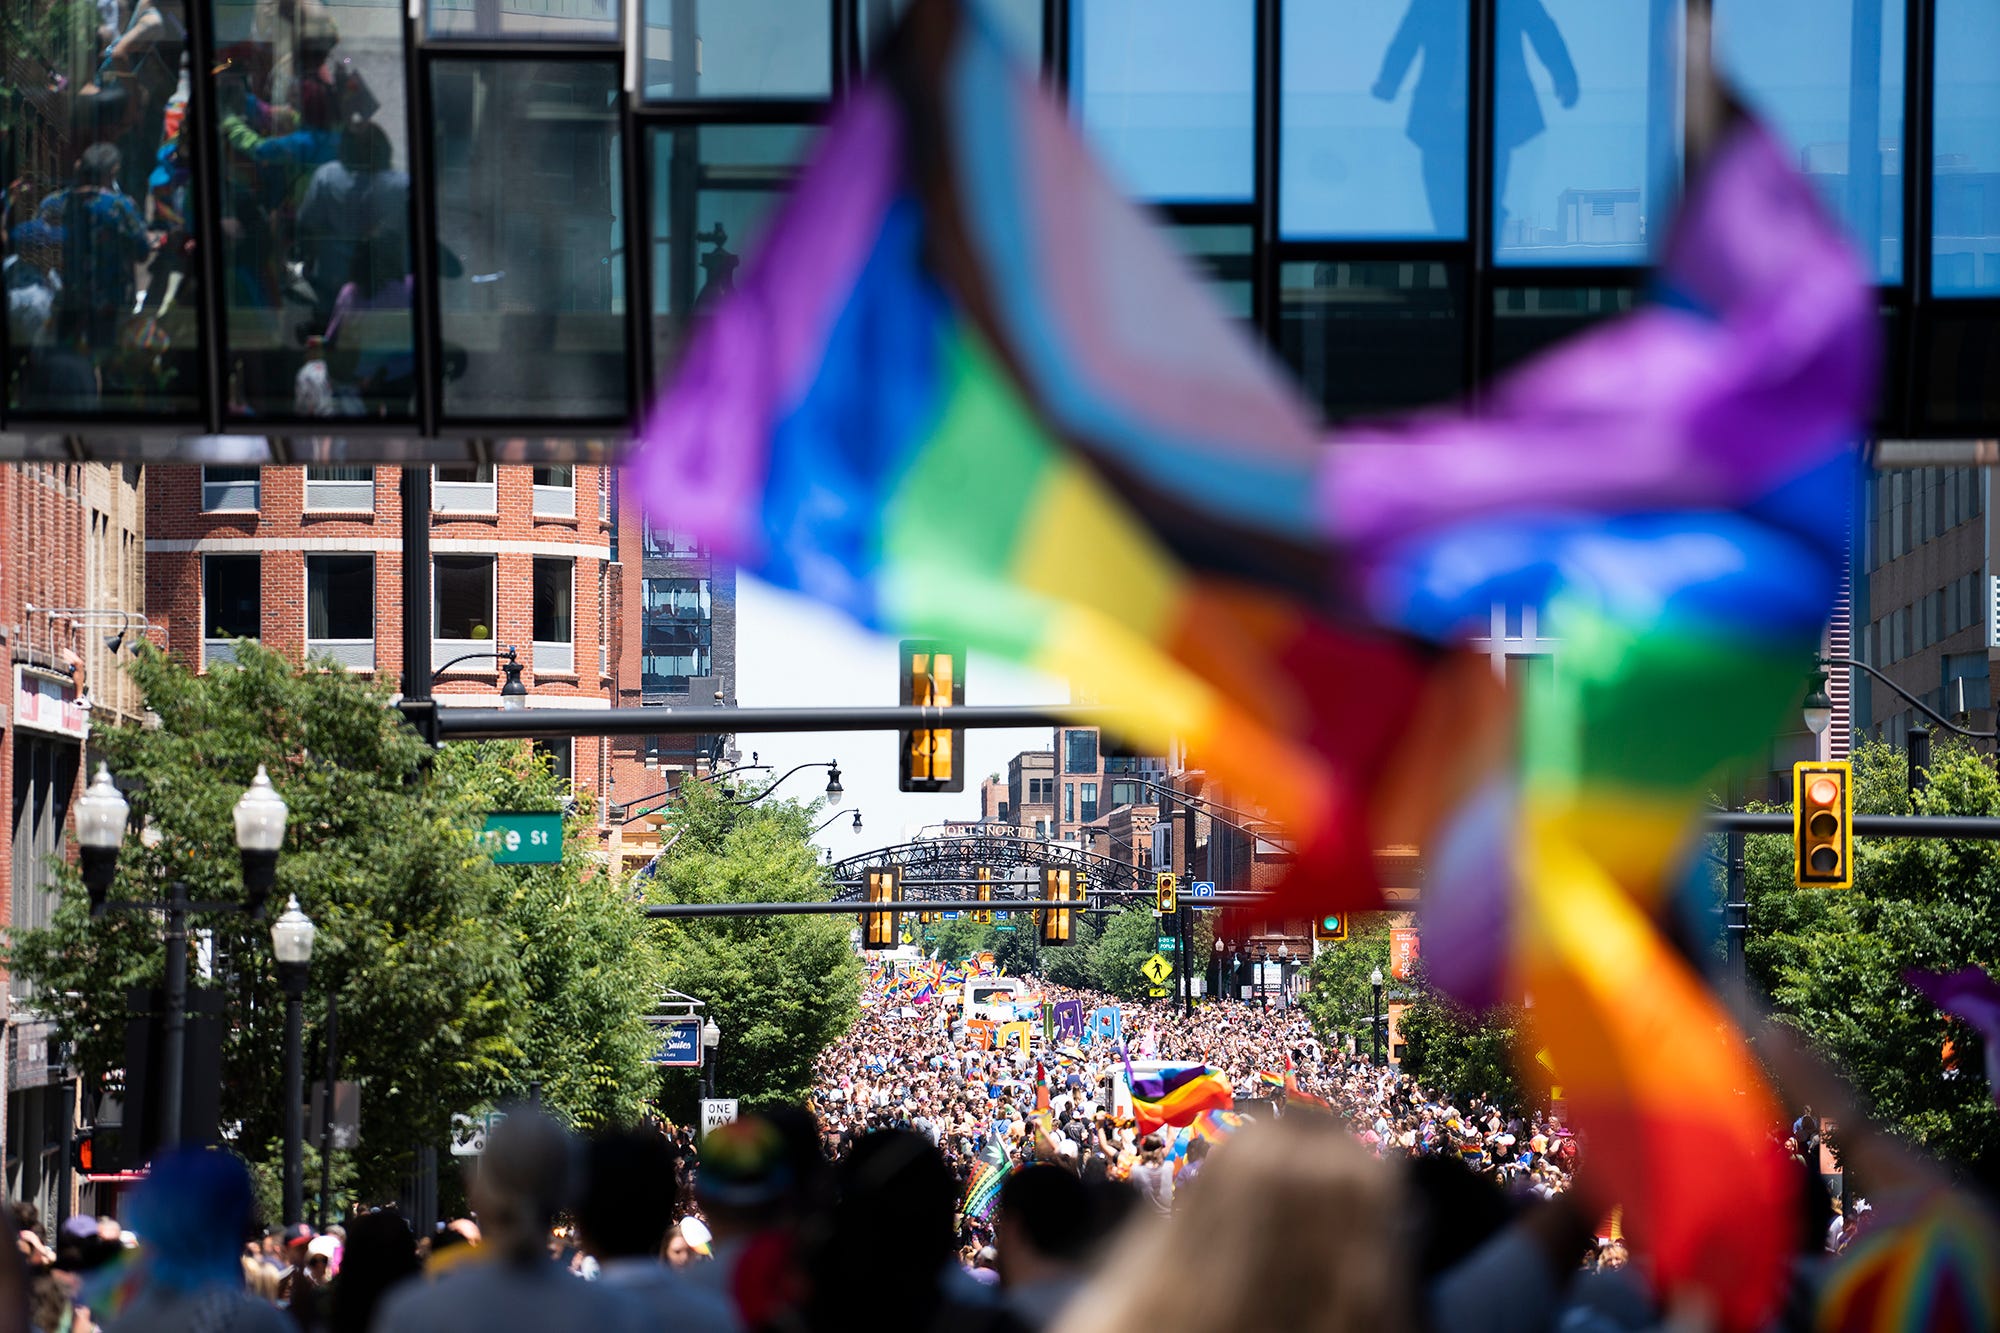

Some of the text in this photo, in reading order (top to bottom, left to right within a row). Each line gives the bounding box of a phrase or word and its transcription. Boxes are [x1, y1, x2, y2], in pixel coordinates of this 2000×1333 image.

[530, 830, 548, 845] St
[986, 825, 1036, 839] NORTH
[667, 1039, 691, 1050] Suites
[708, 1103, 731, 1114] ONE
[708, 1115, 731, 1126] WAY
